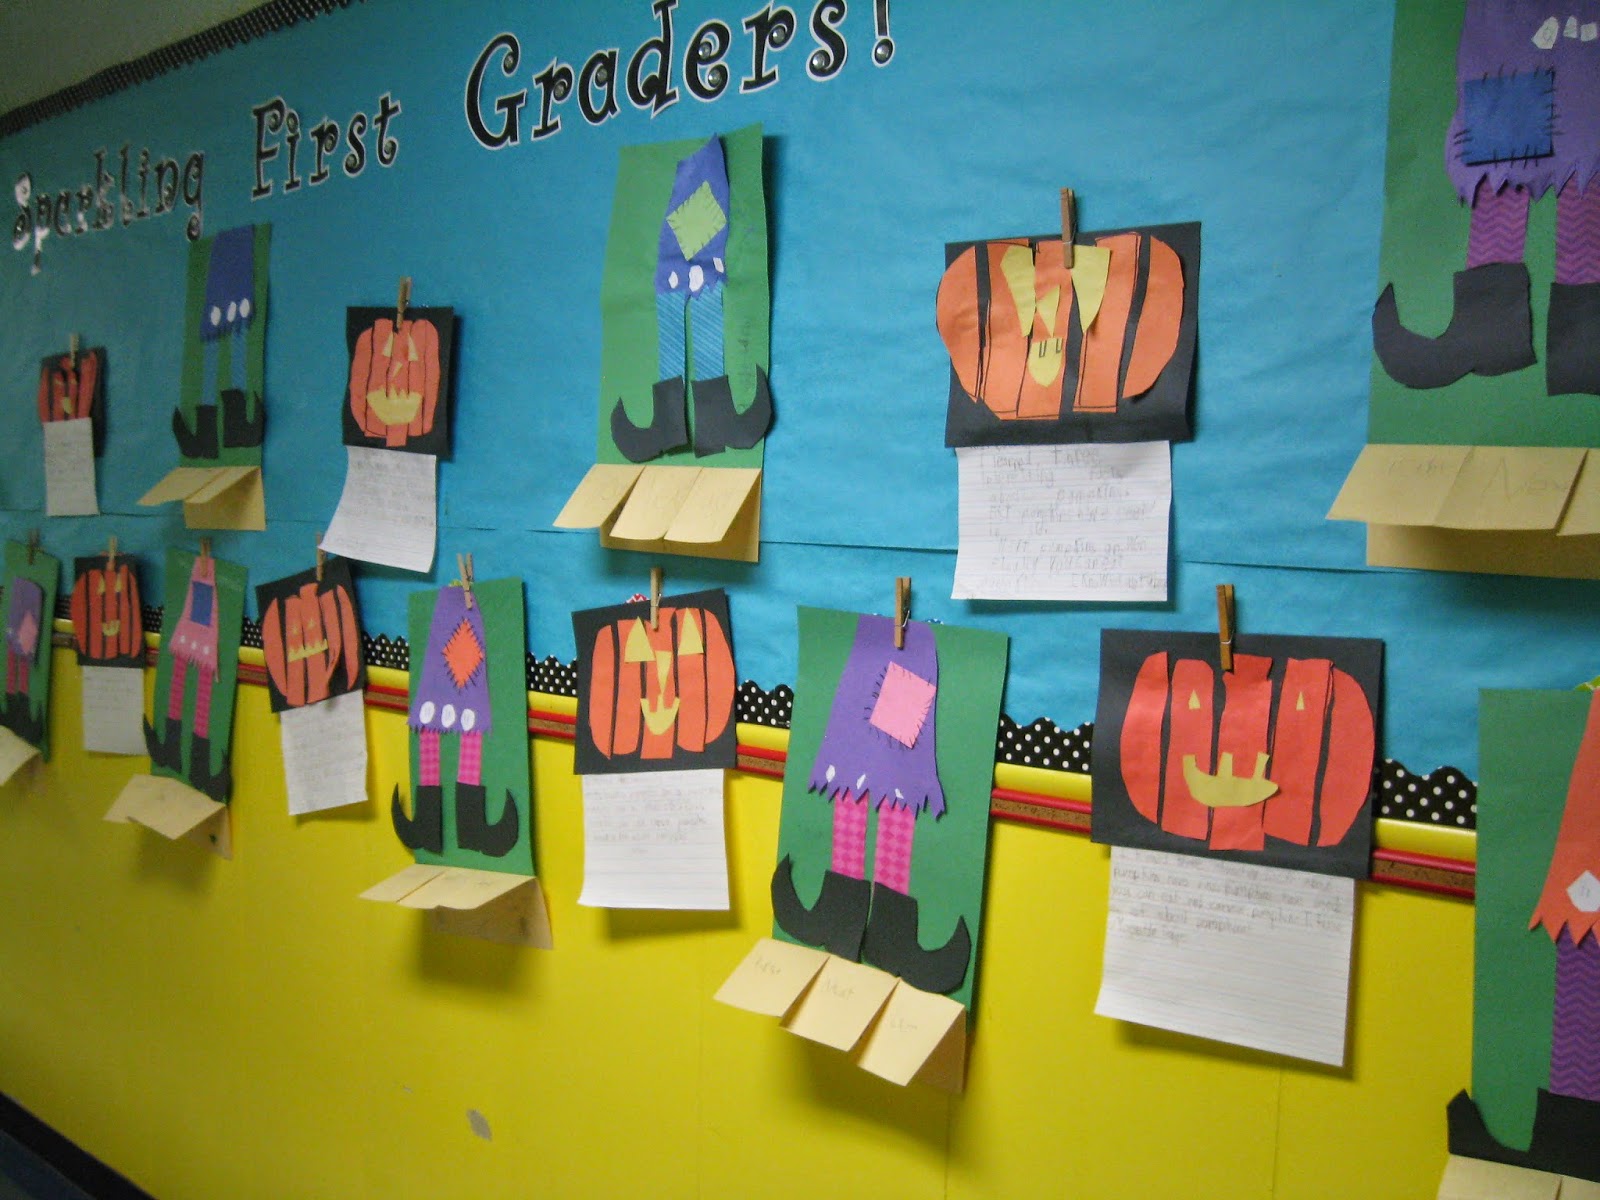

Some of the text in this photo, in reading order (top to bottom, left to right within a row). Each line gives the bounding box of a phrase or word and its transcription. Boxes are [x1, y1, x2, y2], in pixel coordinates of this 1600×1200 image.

[12, 0, 895, 276] Sparkling First Graders!
